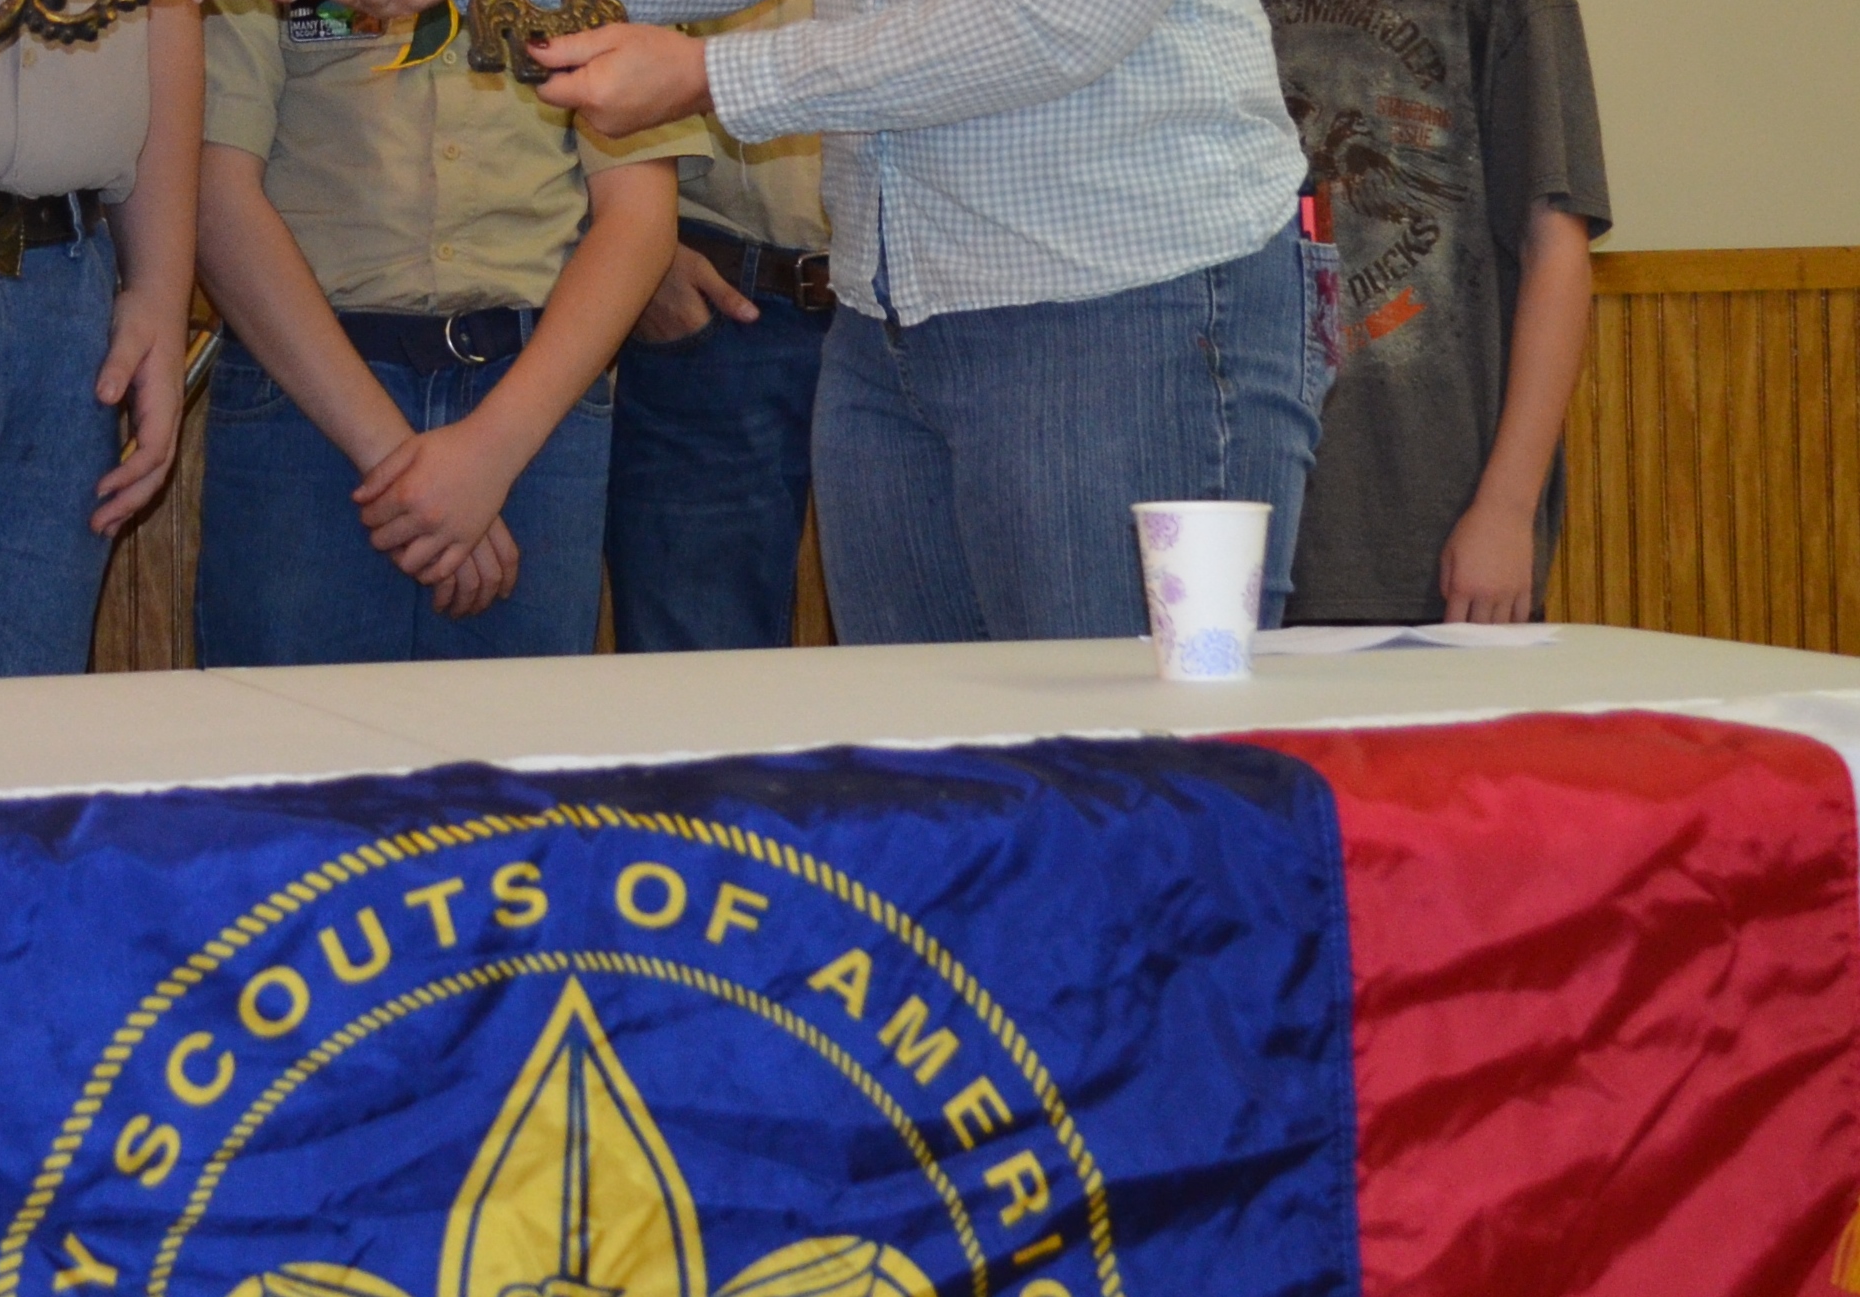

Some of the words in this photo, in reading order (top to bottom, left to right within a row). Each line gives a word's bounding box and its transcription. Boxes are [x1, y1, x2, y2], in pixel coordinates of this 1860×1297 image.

[1347, 215, 1440, 307] DUCKS
[113, 860, 549, 1188] SCOUTS
[613, 860, 769, 946] OF
